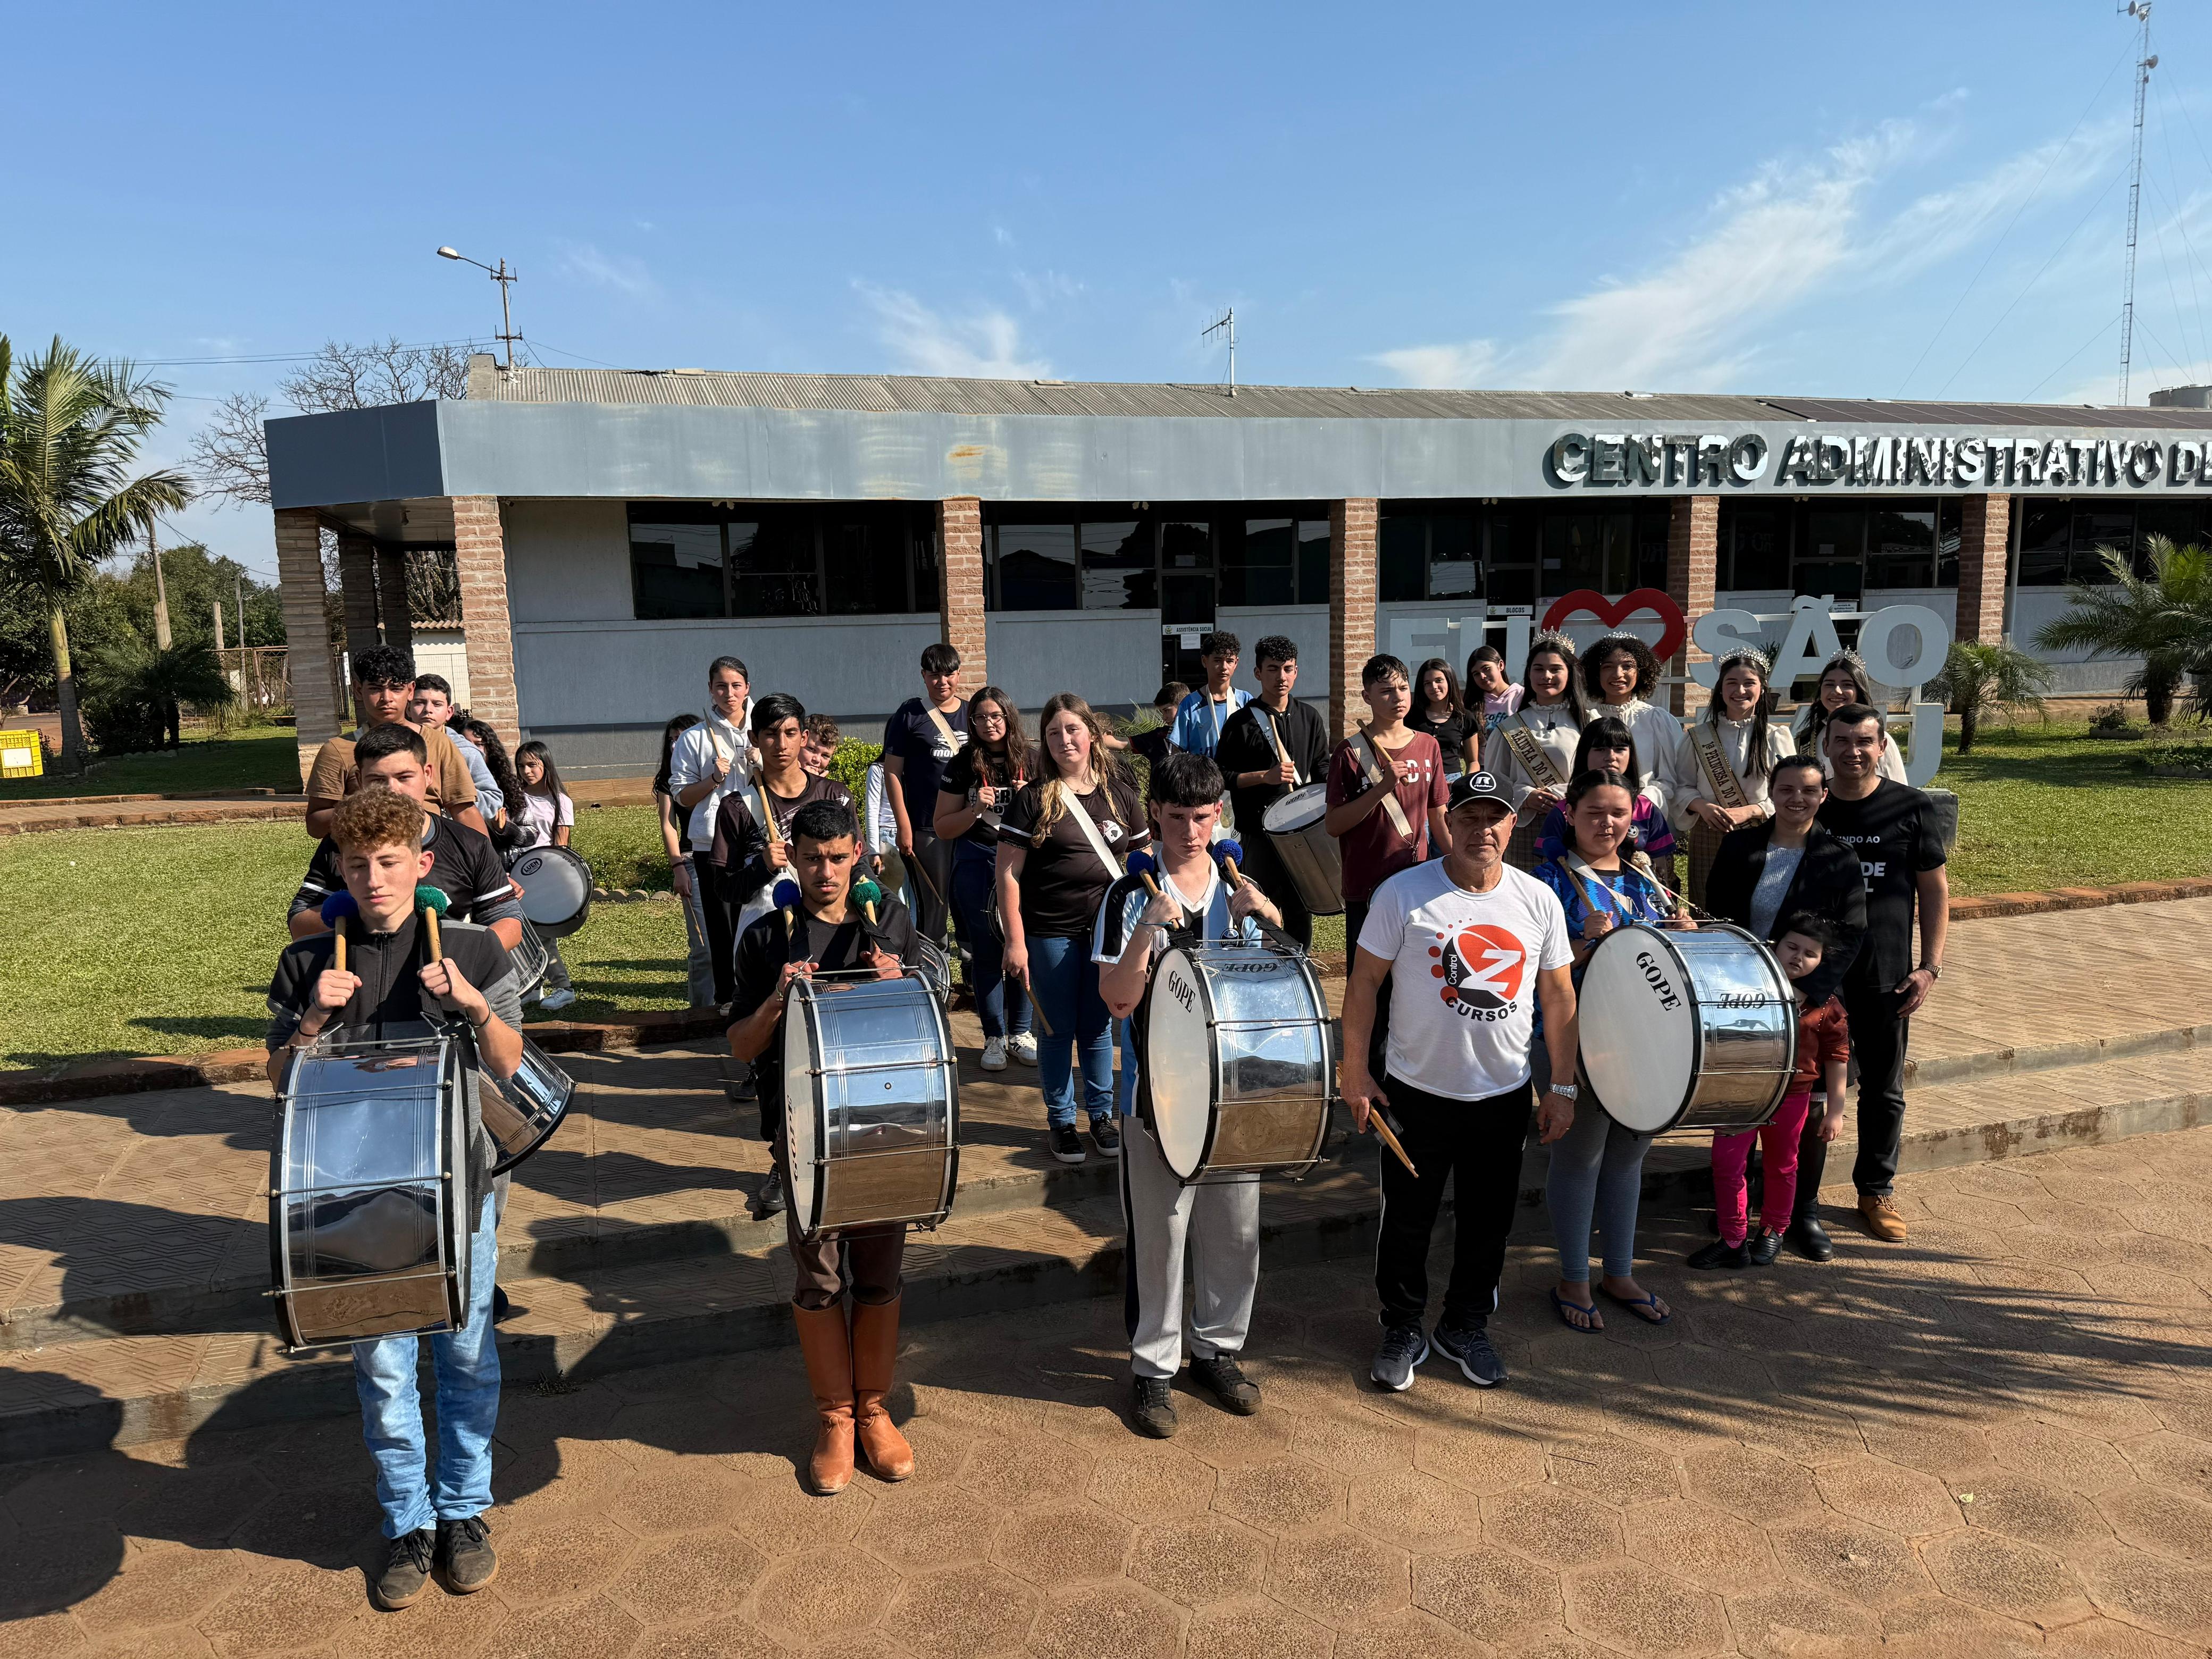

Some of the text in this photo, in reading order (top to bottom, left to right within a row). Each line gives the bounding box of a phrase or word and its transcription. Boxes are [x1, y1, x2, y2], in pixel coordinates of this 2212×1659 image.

[1554, 433, 2212, 482] CENTRO ADMINISTRATIVO D
[1691, 594, 1949, 688] SÃO
[1511, 731, 1538, 764] RAINHA
[1532, 761, 1548, 776] DO
[1705, 749, 1730, 787] PRINCESA
[1722, 786, 1736, 799] DO
[524, 860, 539, 873] LUEN
[1222, 962, 1277, 973] GOPE
[1448, 954, 1457, 985] Control
[1636, 951, 1682, 1011] GOPE
[1168, 970, 1196, 1013] GOPE
[1445, 996, 1518, 1021] CURSOS
